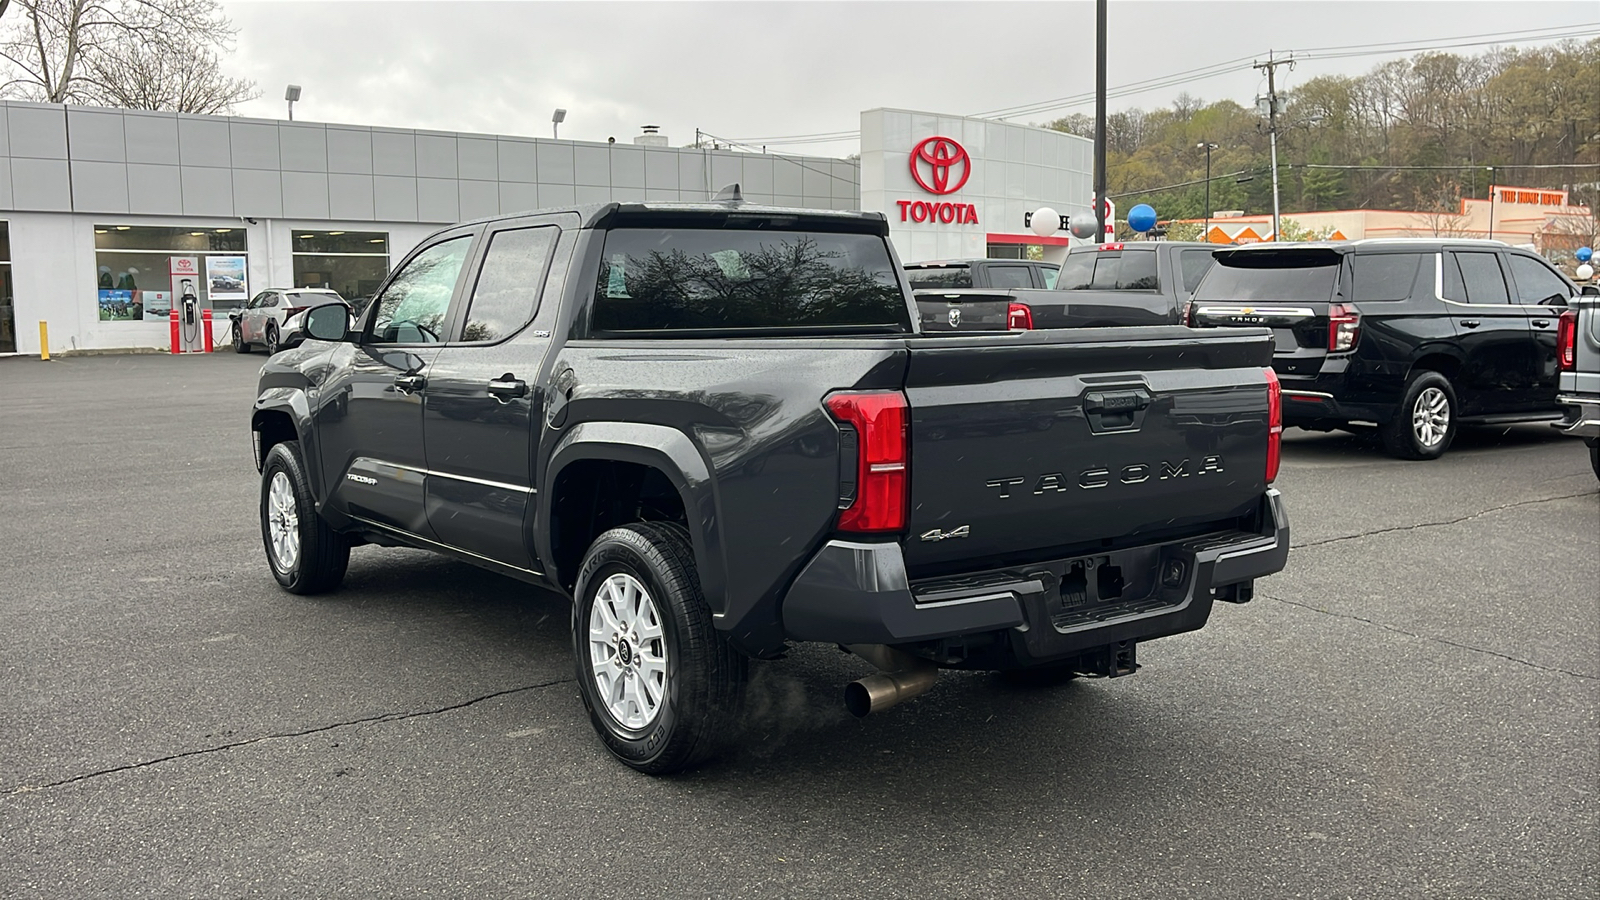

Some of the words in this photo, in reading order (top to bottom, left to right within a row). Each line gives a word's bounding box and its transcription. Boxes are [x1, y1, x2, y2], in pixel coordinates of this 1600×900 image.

[1518, 191, 1539, 205] HOME
[1541, 193, 1564, 206] DEPOT
[896, 200, 979, 225] TOYOTA
[347, 473, 379, 486] TACOMA
[986, 453, 1225, 499] TACOMA
